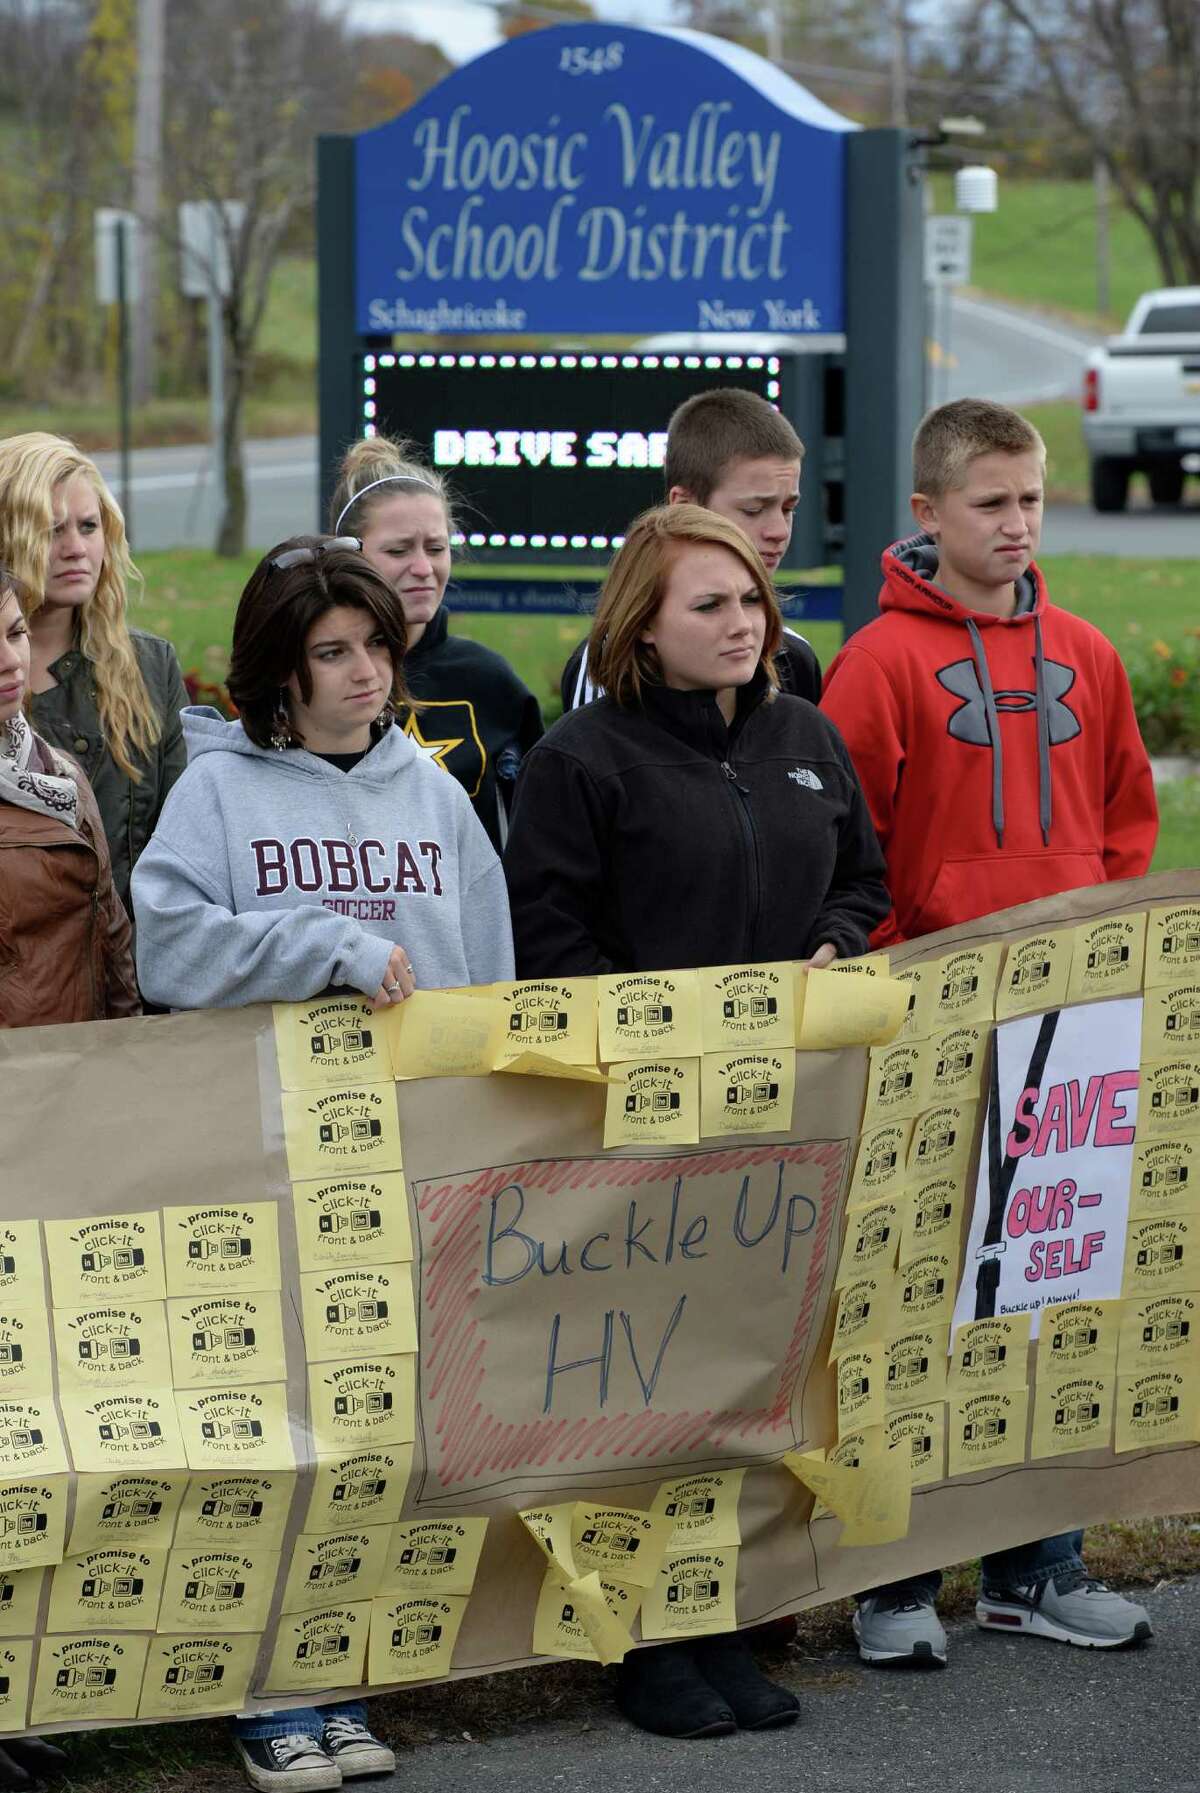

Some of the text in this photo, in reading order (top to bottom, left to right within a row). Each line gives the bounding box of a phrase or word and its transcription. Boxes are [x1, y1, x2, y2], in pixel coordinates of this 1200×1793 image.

[559, 41, 624, 76] 1548
[407, 101, 781, 218] Hoosic Valley
[396, 195, 792, 281] School District
[698, 298, 821, 330] New York
[434, 430, 577, 466] DRIVE
[914, 584, 953, 610] ARMOUR
[250, 837, 443, 896] BOBCAT
[1090, 921, 1123, 938] promise
[1125, 923, 1134, 933] to
[722, 968, 766, 985] promise
[769, 972, 780, 983] to
[512, 982, 558, 998] promise
[561, 987, 573, 999] to
[726, 983, 770, 998] click-it
[308, 1002, 357, 1020] promise
[361, 1004, 373, 1016] to
[515, 997, 561, 1011] click-it
[314, 1017, 363, 1034] click-it
[721, 1015, 780, 1031] front & back
[506, 1030, 570, 1043] front & back
[310, 1048, 376, 1066] front & back
[726, 1055, 769, 1071] promise
[771, 1058, 782, 1069] to
[730, 1069, 772, 1084] click-it
[317, 1091, 366, 1109] promise
[369, 1093, 382, 1105] to
[723, 1104, 747, 1116] front
[757, 1101, 779, 1113] back
[322, 1106, 372, 1122] click-it
[1006, 1070, 1140, 1158] SAVE
[318, 1143, 348, 1155] front
[360, 1137, 385, 1152] back
[187, 1208, 238, 1225] promise
[242, 1212, 254, 1224] to
[1007, 1179, 1101, 1238] OUR-
[78, 1219, 129, 1238] promise
[133, 1222, 145, 1234] to
[192, 1223, 243, 1239] click-it
[482, 1160, 816, 1285] Buckle Up
[84, 1234, 134, 1251] click-it
[186, 1256, 256, 1272] front & back
[1025, 1231, 1105, 1282] SELF
[80, 1267, 149, 1284] front & back
[324, 1272, 374, 1289] promise
[377, 1274, 390, 1287] to
[330, 1286, 378, 1303] click-it
[1000, 1303, 1028, 1314] Buckle
[1145, 1296, 1182, 1313] promise
[1185, 1299, 1194, 1309] to
[325, 1319, 392, 1335] front & back
[544, 1295, 687, 1413] HV
[1057, 1378, 1093, 1396] promise
[1095, 1380, 1104, 1390] to
[593, 1520, 637, 1535] click-it
[594, 1510, 640, 1522] promise
[641, 1519, 652, 1529] to
[575, 1542, 636, 1560] front & back
[669, 1555, 711, 1571] promise
[714, 1555, 724, 1567] to
[672, 1568, 714, 1583] click-it
[396, 1598, 438, 1614] promise
[441, 1602, 451, 1613] to
[664, 1600, 722, 1614] front & back
[397, 1611, 438, 1627] click-it
[61, 1638, 110, 1654] promise
[113, 1643, 124, 1656] to
[389, 1643, 441, 1659] front & back
[63, 1652, 111, 1667] click-it
[51, 1685, 115, 1699] front & back
